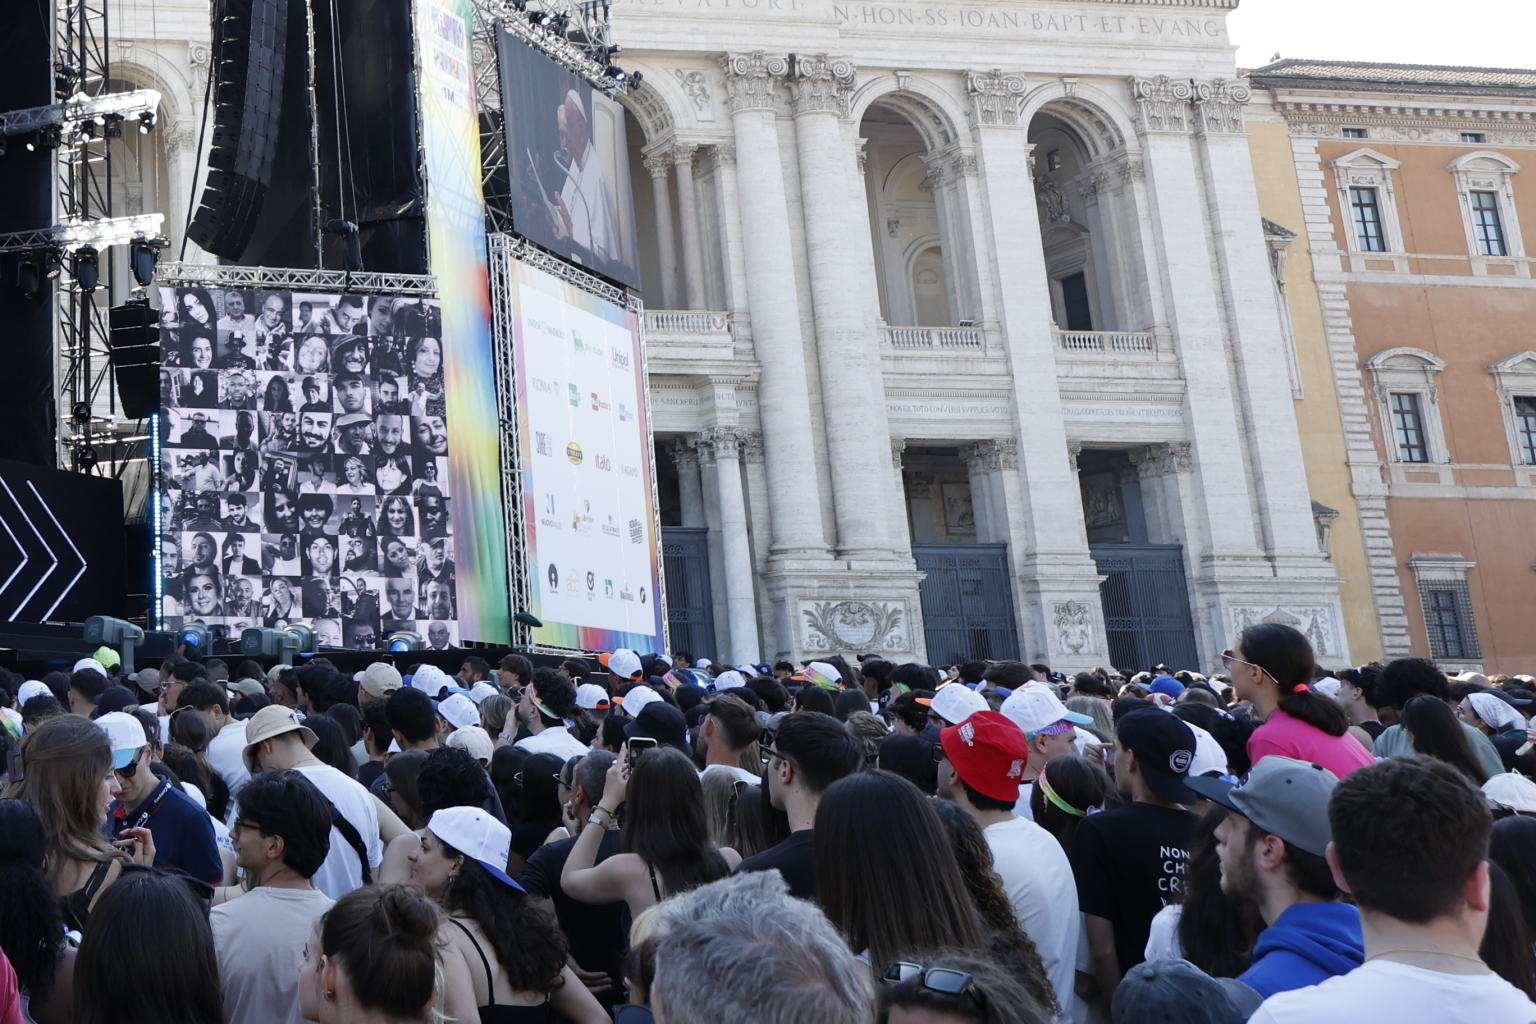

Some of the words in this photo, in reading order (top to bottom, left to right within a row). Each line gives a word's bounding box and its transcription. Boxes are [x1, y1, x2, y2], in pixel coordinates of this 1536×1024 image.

[863, 7, 914, 25] HON
[925, 8, 948, 26] SS
[1031, 13, 1088, 31] BAPT
[1101, 16, 1128, 34] ET
[1139, 17, 1219, 37] EVANG
[1160, 845, 1191, 859] NON
